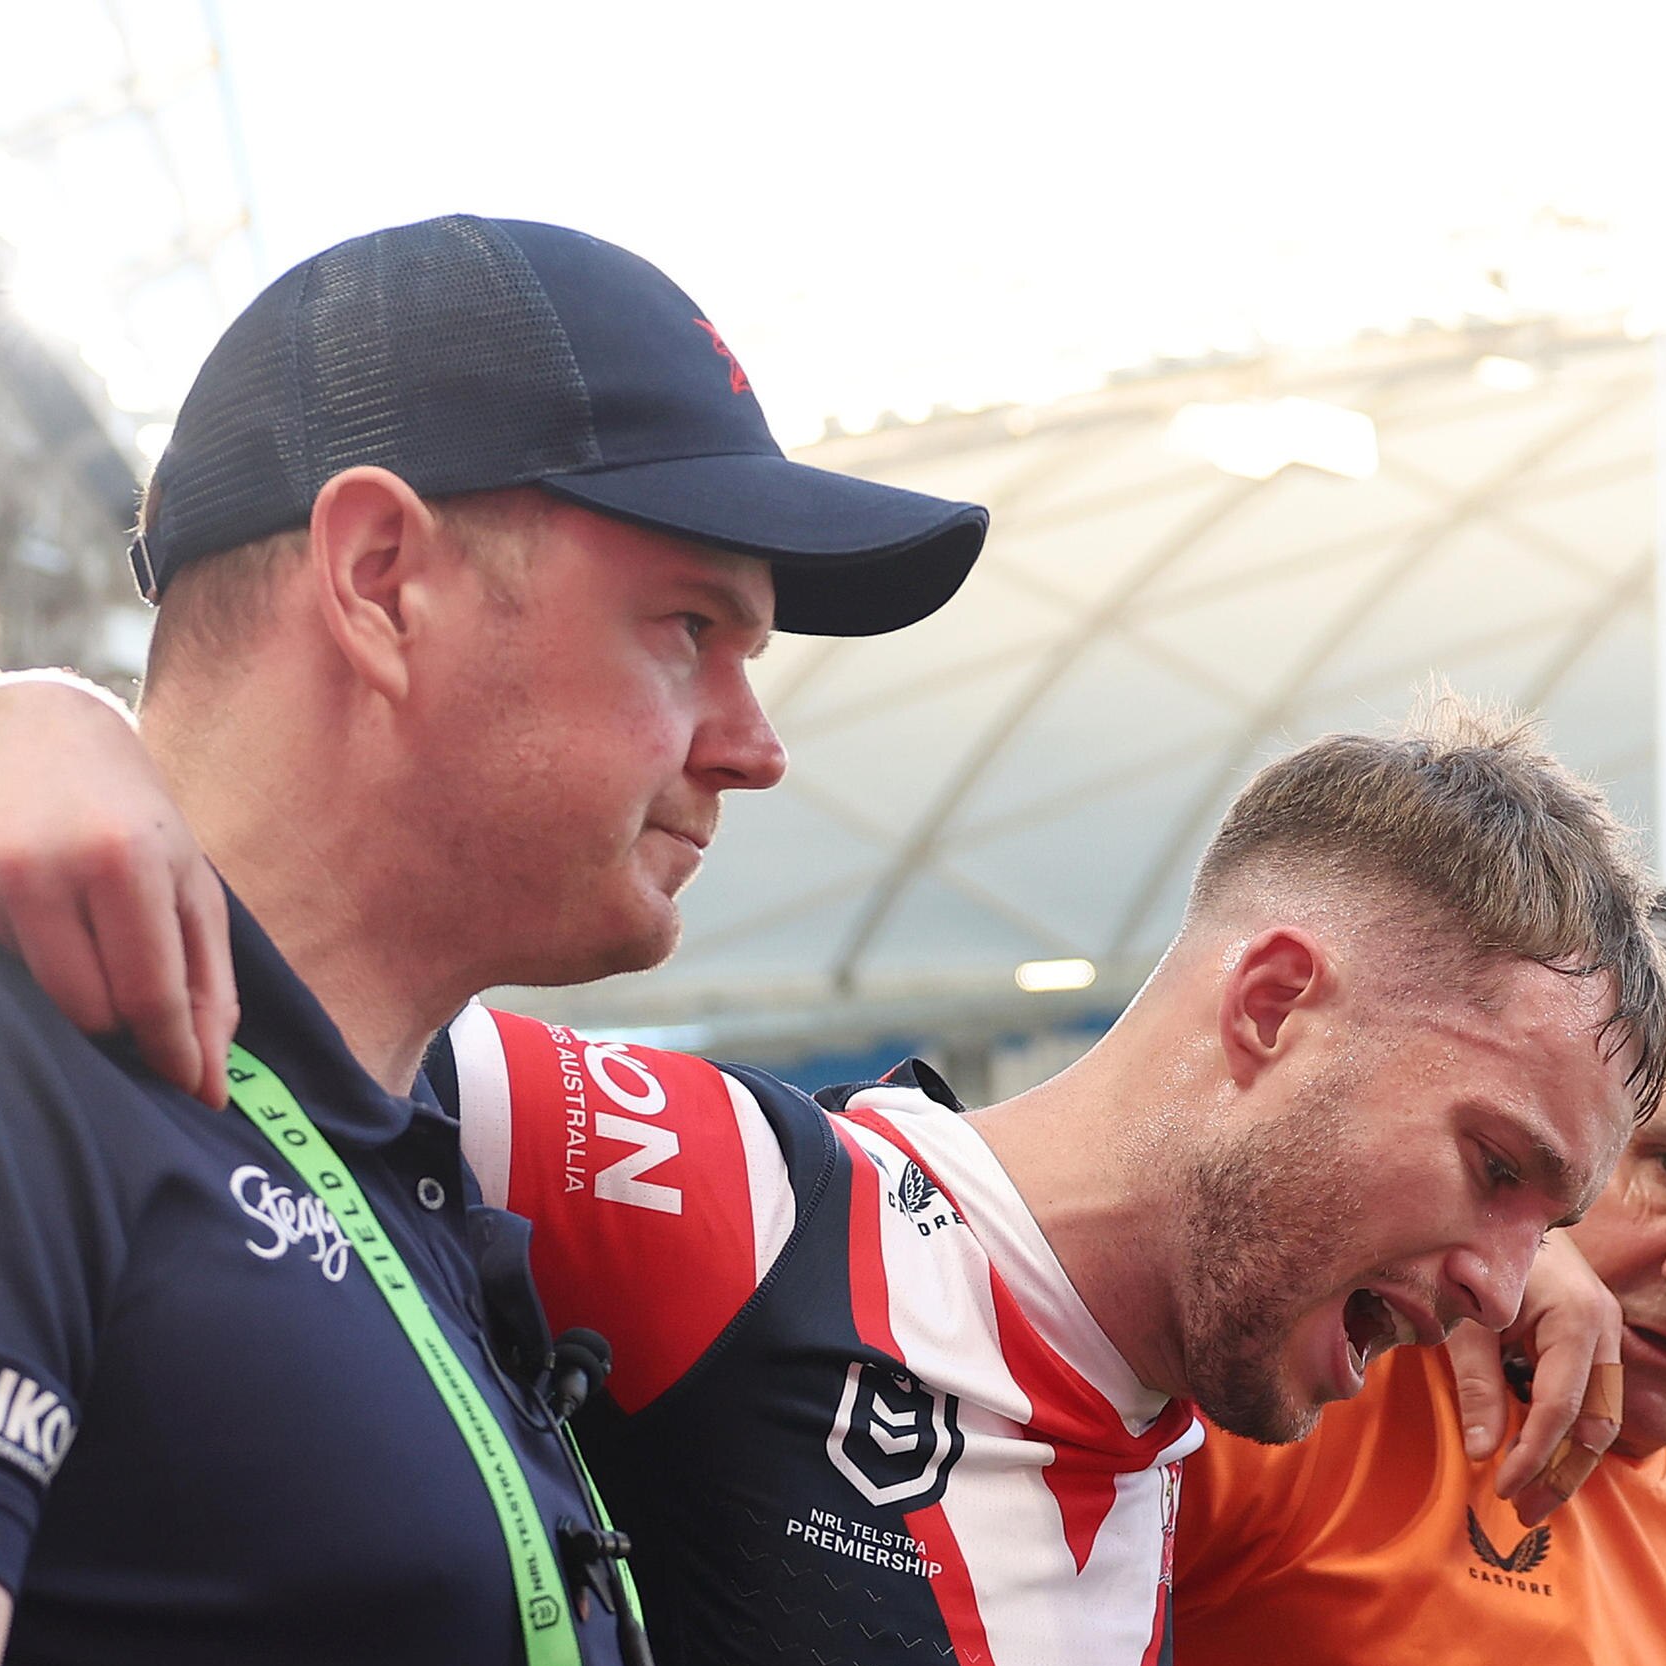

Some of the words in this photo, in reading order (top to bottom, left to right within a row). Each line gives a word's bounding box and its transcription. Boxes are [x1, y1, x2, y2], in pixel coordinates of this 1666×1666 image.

[258, 1105, 308, 1147] OF
[556, 1046, 587, 1194] AUSTRALIA
[229, 1165, 352, 1282] Stegg
[319, 1171, 406, 1290] FIELD
[785, 1518, 943, 1580] PREMIERSHIP
[810, 1507, 847, 1533] NRL
[850, 1521, 928, 1556] TELSTRA
[1468, 1567, 1552, 1597] CASTORE
